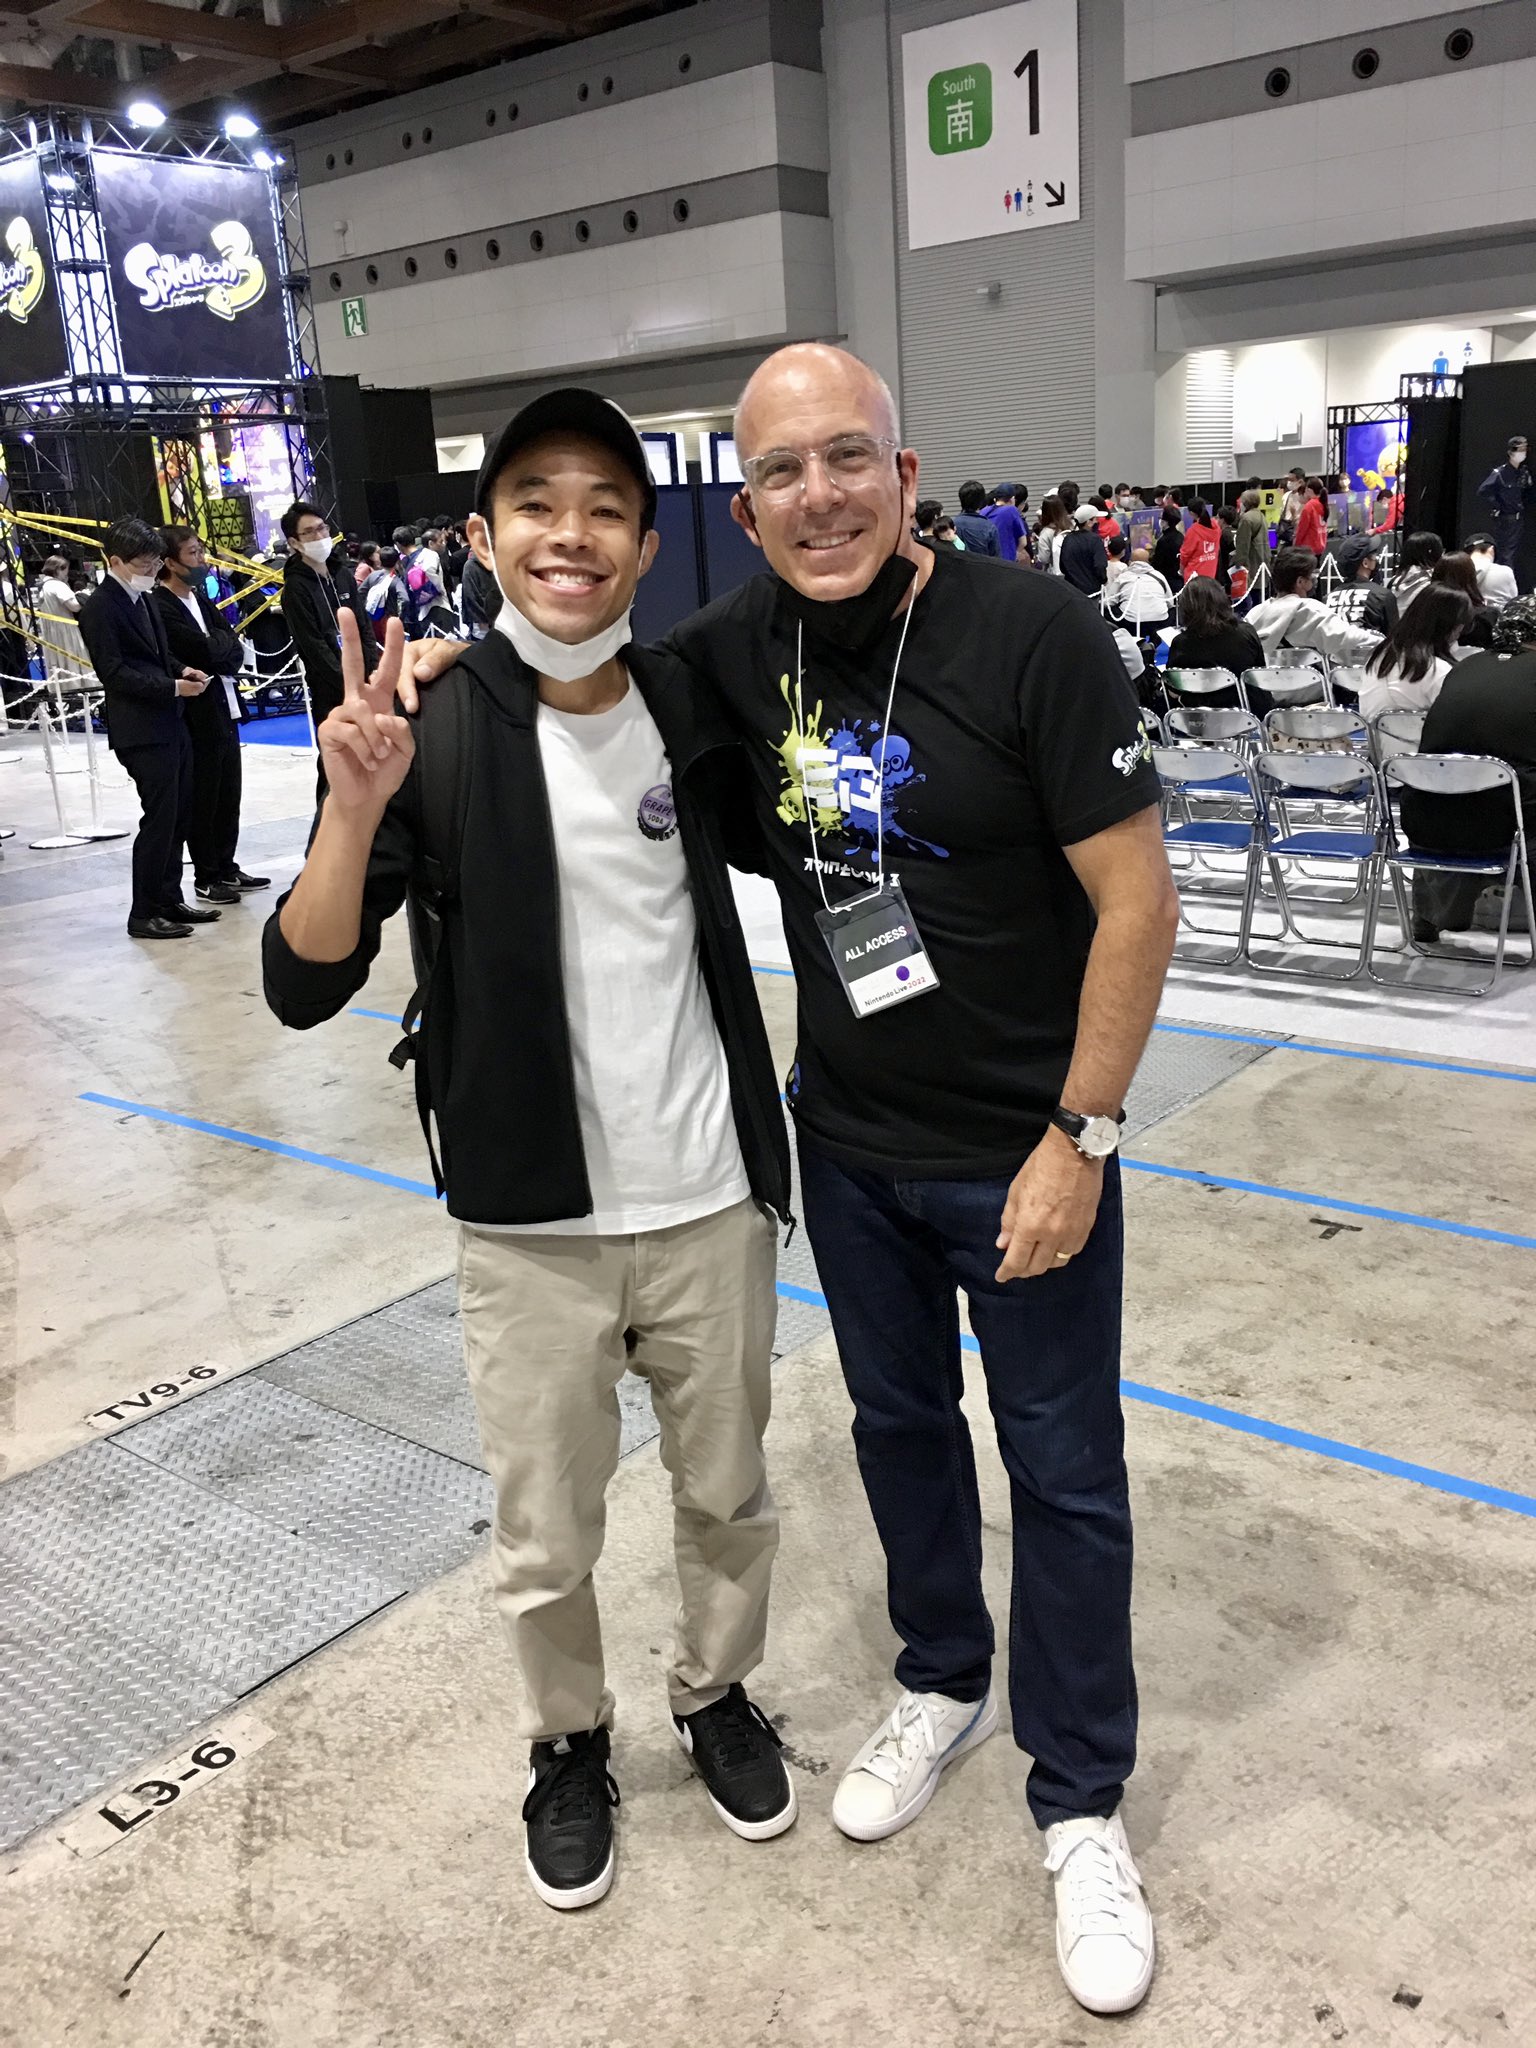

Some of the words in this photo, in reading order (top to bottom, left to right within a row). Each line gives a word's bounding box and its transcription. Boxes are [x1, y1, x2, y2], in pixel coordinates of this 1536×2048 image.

[942, 74, 976, 97] South
[1013, 48, 1040, 136] 1
[945, 98, 974, 145] 南
[124, 242, 239, 311] Splatoon
[844, 946, 865, 962] ALL
[865, 925, 908, 954] ACCESS
[864, 991, 894, 1007] Nintendo
[894, 984, 908, 995] Live
[908, 976, 926, 989] 2022
[93, 1365, 217, 1420] TV9-6
[98, 1740, 236, 1833] L9-6
